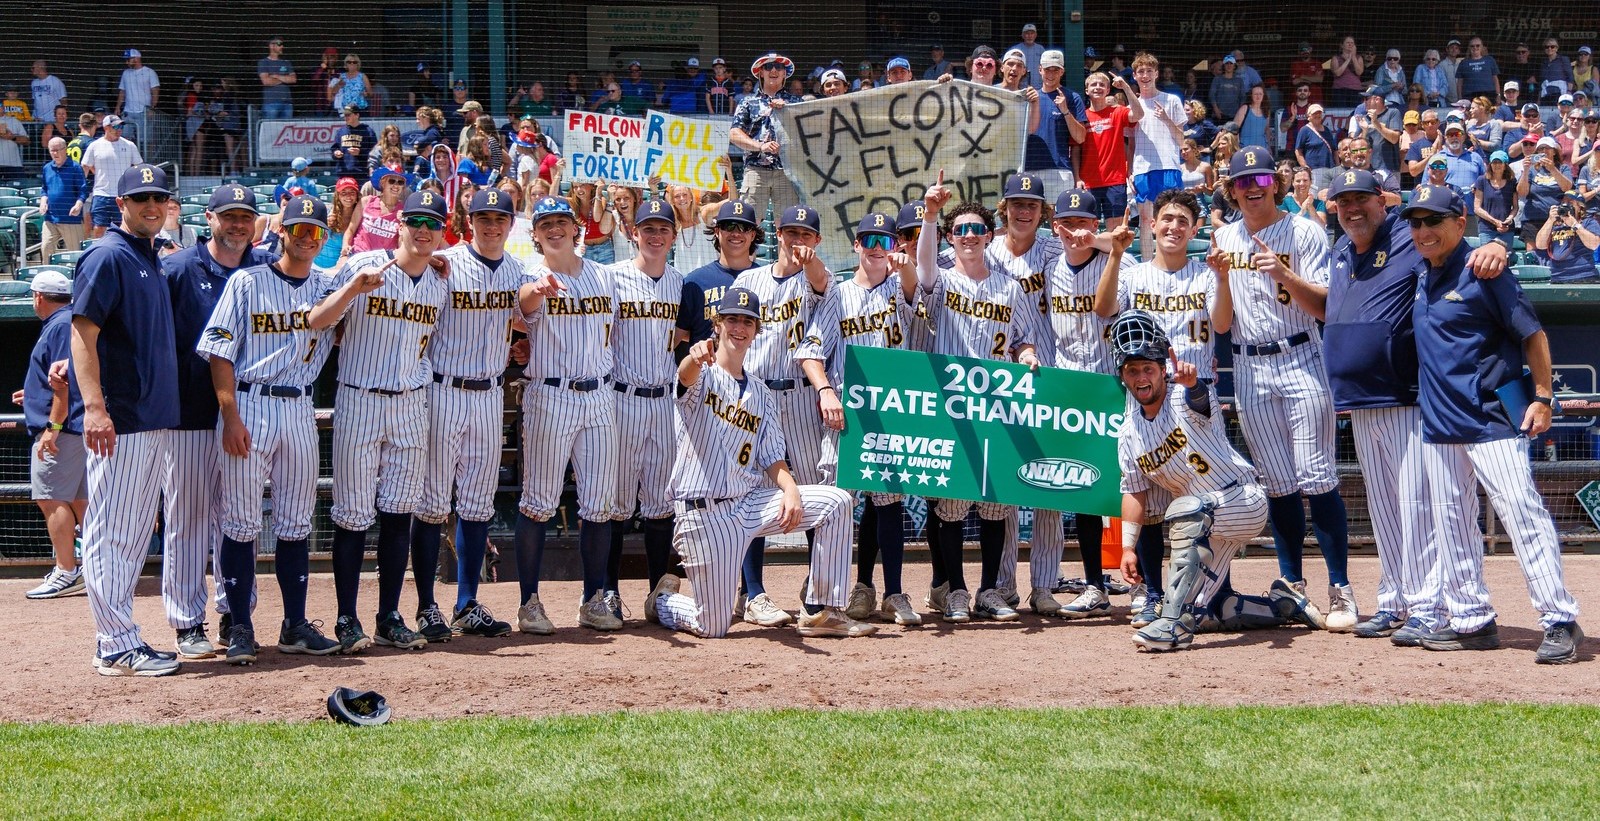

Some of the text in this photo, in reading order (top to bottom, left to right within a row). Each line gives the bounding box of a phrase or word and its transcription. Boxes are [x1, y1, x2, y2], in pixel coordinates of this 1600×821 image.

[607, 9, 700, 20] Where do you
[612, 22, 647, 31] want
[652, 22, 664, 32] to
[1179, 20, 1236, 32] FLASH
[1495, 18, 1552, 30] FLASH
[569, 113, 646, 138] FALCON
[647, 114, 714, 152] ROLL
[794, 86, 1004, 156] FALCONS
[592, 136, 626, 156] FLY
[644, 148, 722, 190] FALCS
[859, 133, 942, 187] FLY
[366, 296, 438, 325] FALCONS
[944, 291, 1012, 324] FALCONS
[1132, 292, 1206, 314] FALCONS
[992, 332, 1006, 356] 2
[1188, 320, 1209, 343] 15
[943, 363, 1036, 400] 2024
[846, 384, 1126, 438] STATE CHAMPIONS
[738, 442, 752, 467] 6
[860, 432, 956, 458] SERVICE
[1136, 426, 1188, 475] FALCONS
[860, 452, 952, 470] CREDIT UNION
[1188, 452, 1211, 475] 3
